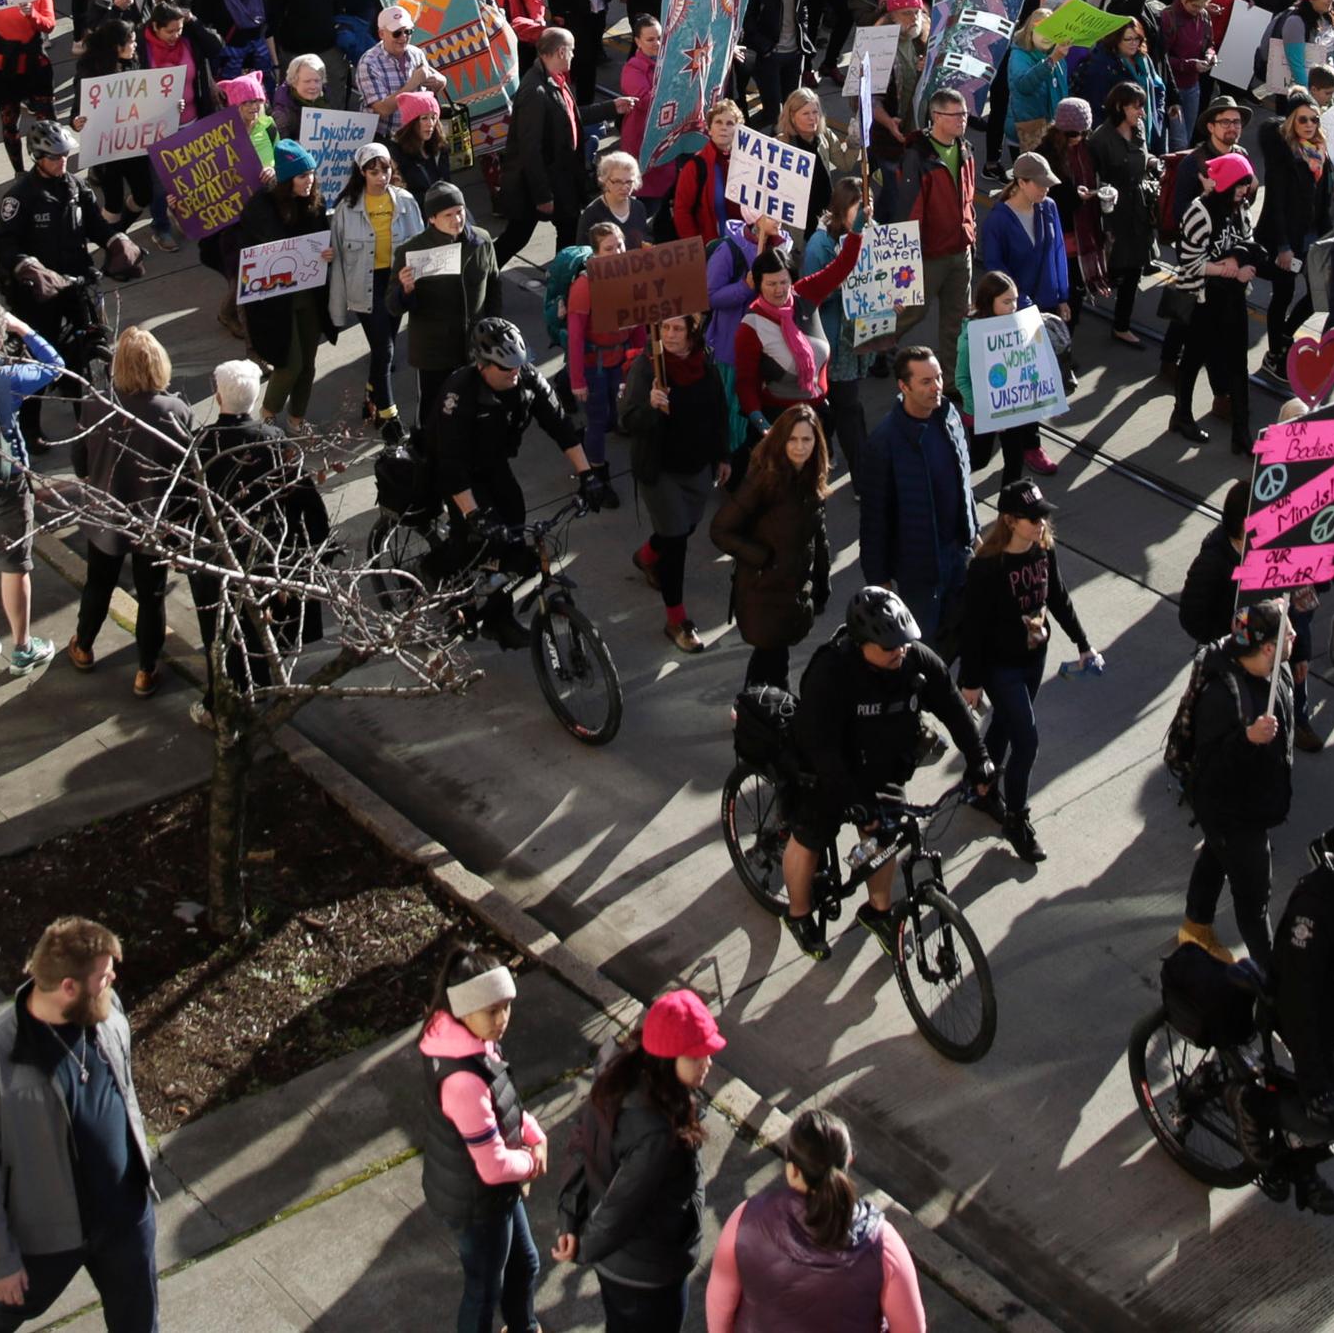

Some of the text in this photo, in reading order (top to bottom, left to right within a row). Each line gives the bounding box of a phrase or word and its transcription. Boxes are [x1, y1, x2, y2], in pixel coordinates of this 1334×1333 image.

[106, 78, 148, 100] VIVA
[115, 104, 140, 124] LA
[98, 121, 166, 156] MUJER
[161, 122, 236, 172] DEMOCRACY
[737, 130, 811, 177] WATER
[173, 149, 240, 194] IS NOT A
[756, 168, 779, 190] IS
[178, 168, 244, 220] SPECTATOR
[739, 184, 795, 223] LIFE
[874, 225, 899, 241] We
[243, 239, 298, 259] WE ARE ALL
[588, 245, 702, 282] HANDS OFF
[633, 279, 664, 299] MY
[616, 297, 683, 326] PUSSY
[1003, 345, 1038, 369] WOMEN
[1285, 421, 1309, 437] OUR
[1269, 494, 1292, 513] OUR
[1278, 477, 1334, 532] Minds!
[1265, 547, 1292, 564] OUR
[857, 703, 881, 715] POLICE
